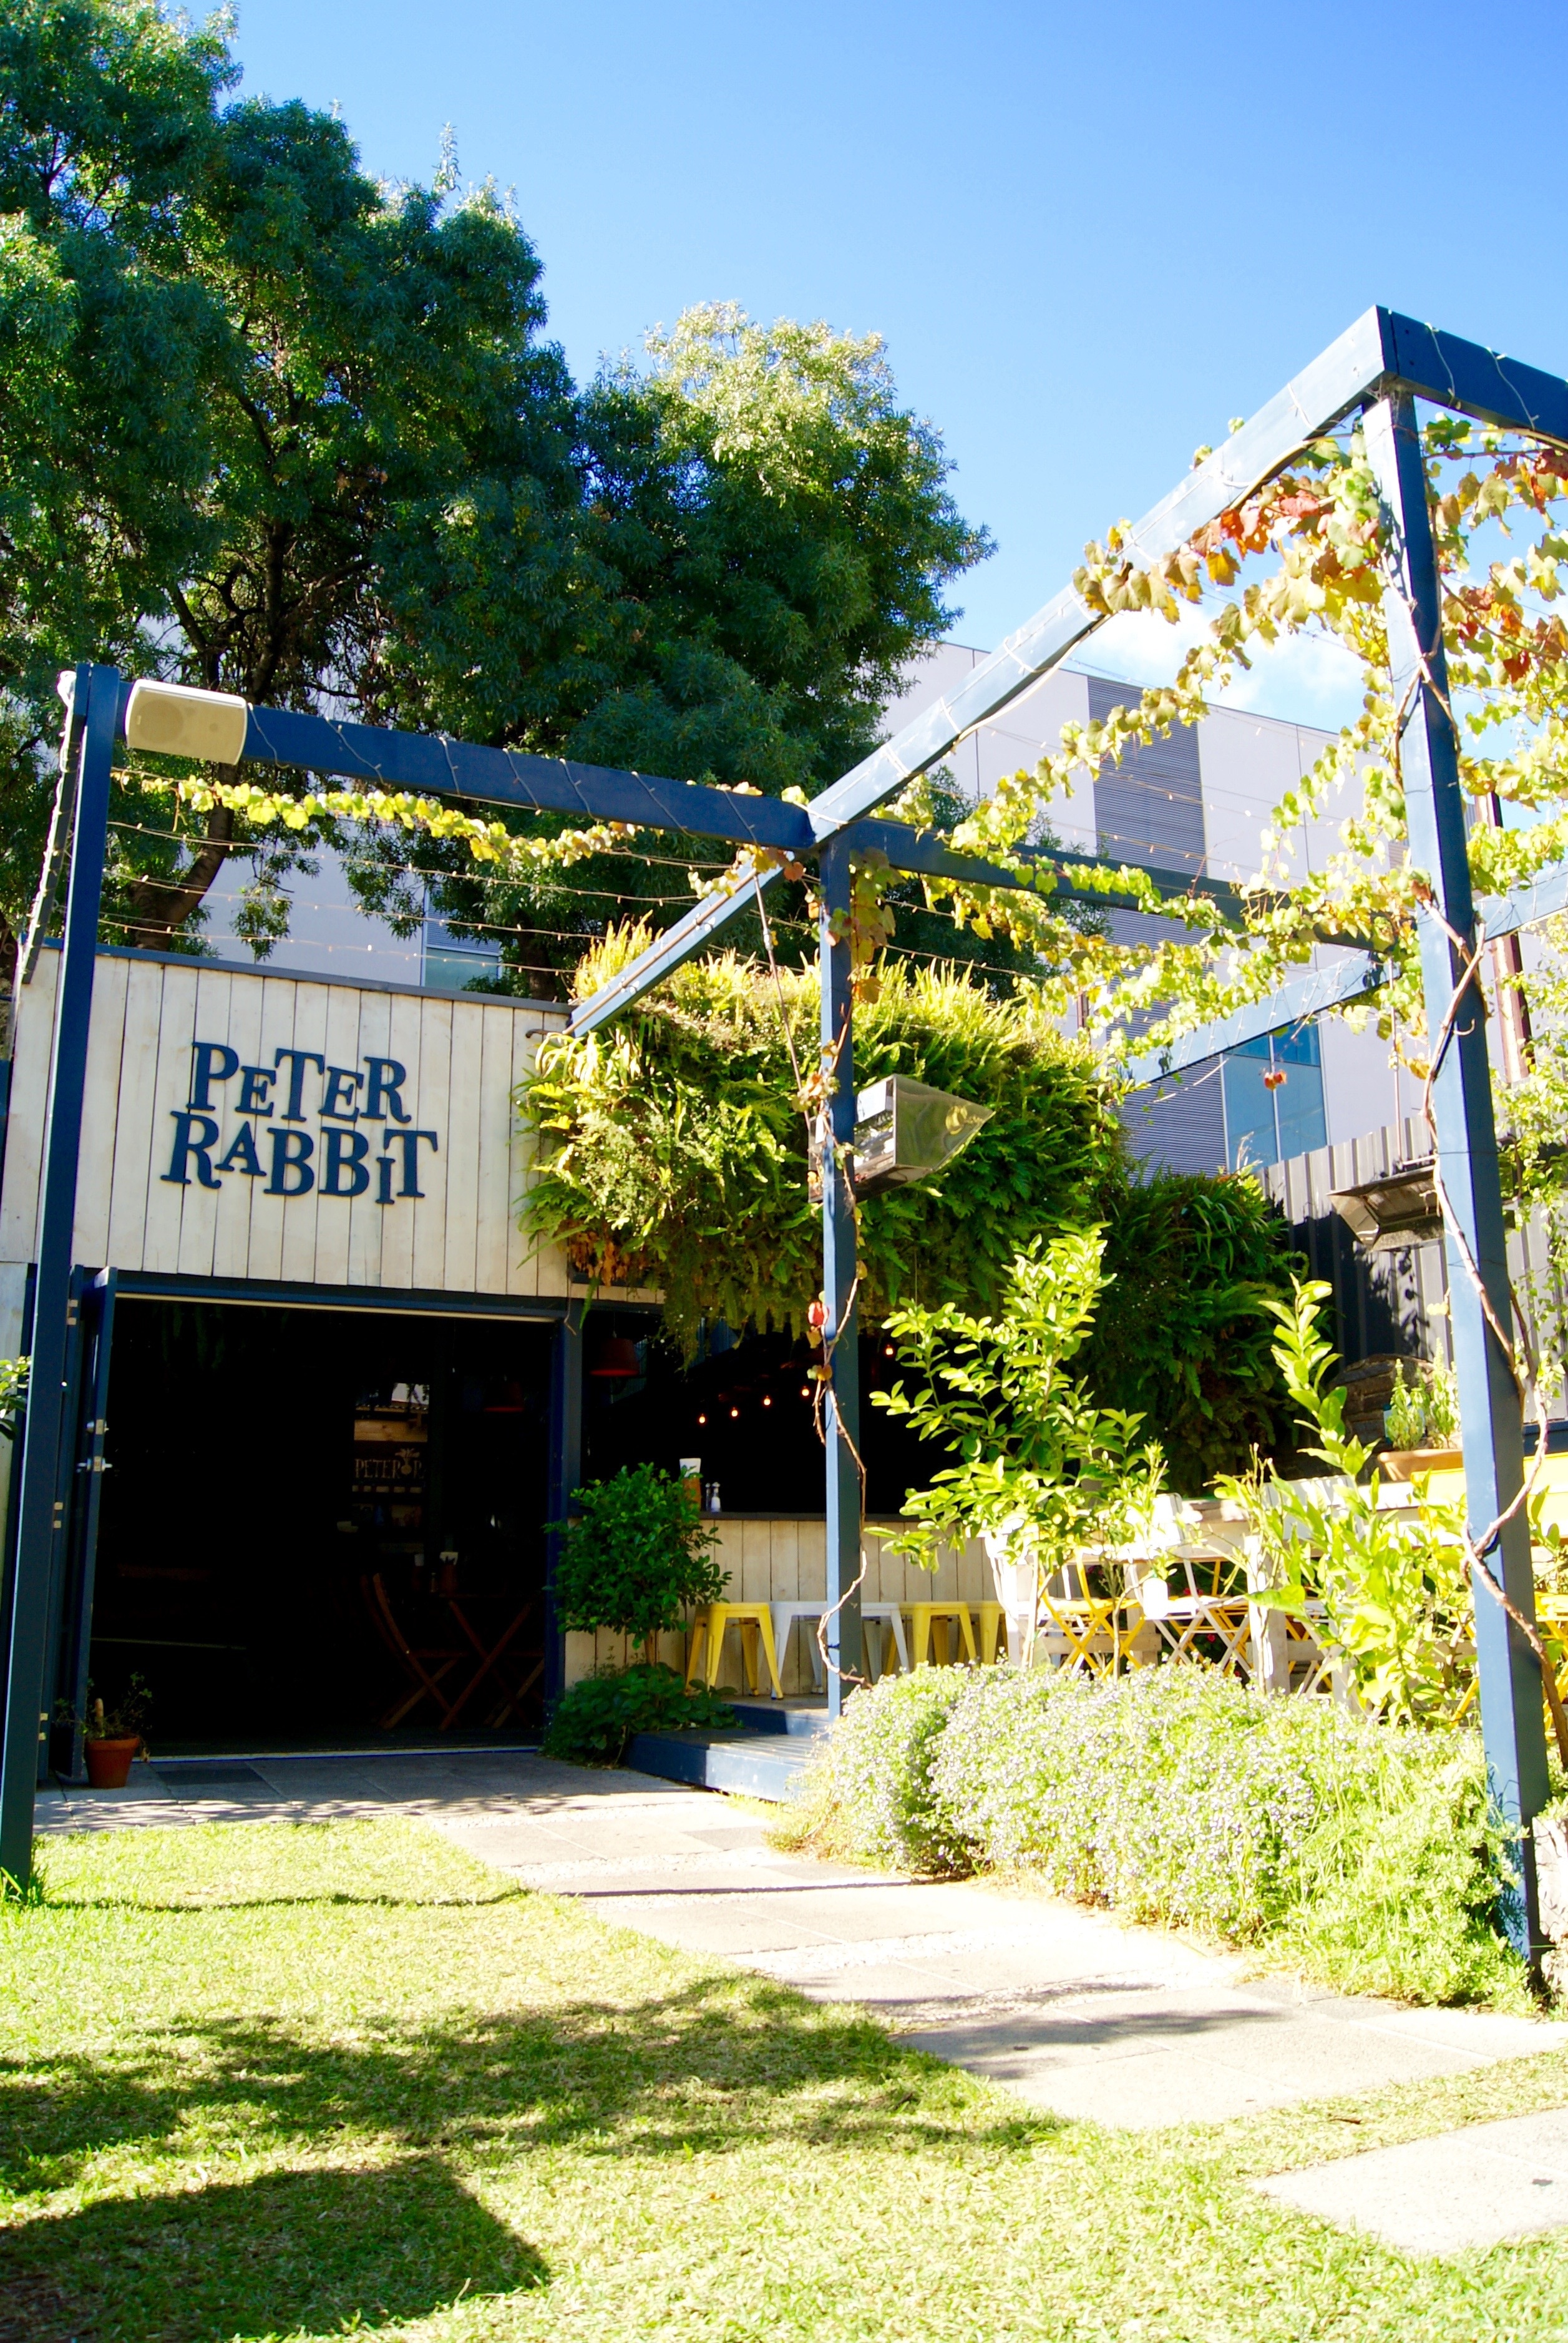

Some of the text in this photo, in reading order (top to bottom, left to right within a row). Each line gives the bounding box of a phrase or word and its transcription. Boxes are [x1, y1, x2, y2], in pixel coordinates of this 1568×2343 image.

[186, 1041, 411, 1123] PETER
[160, 1111, 437, 1205] RABBIT
[354, 1458, 401, 1479] PETER
